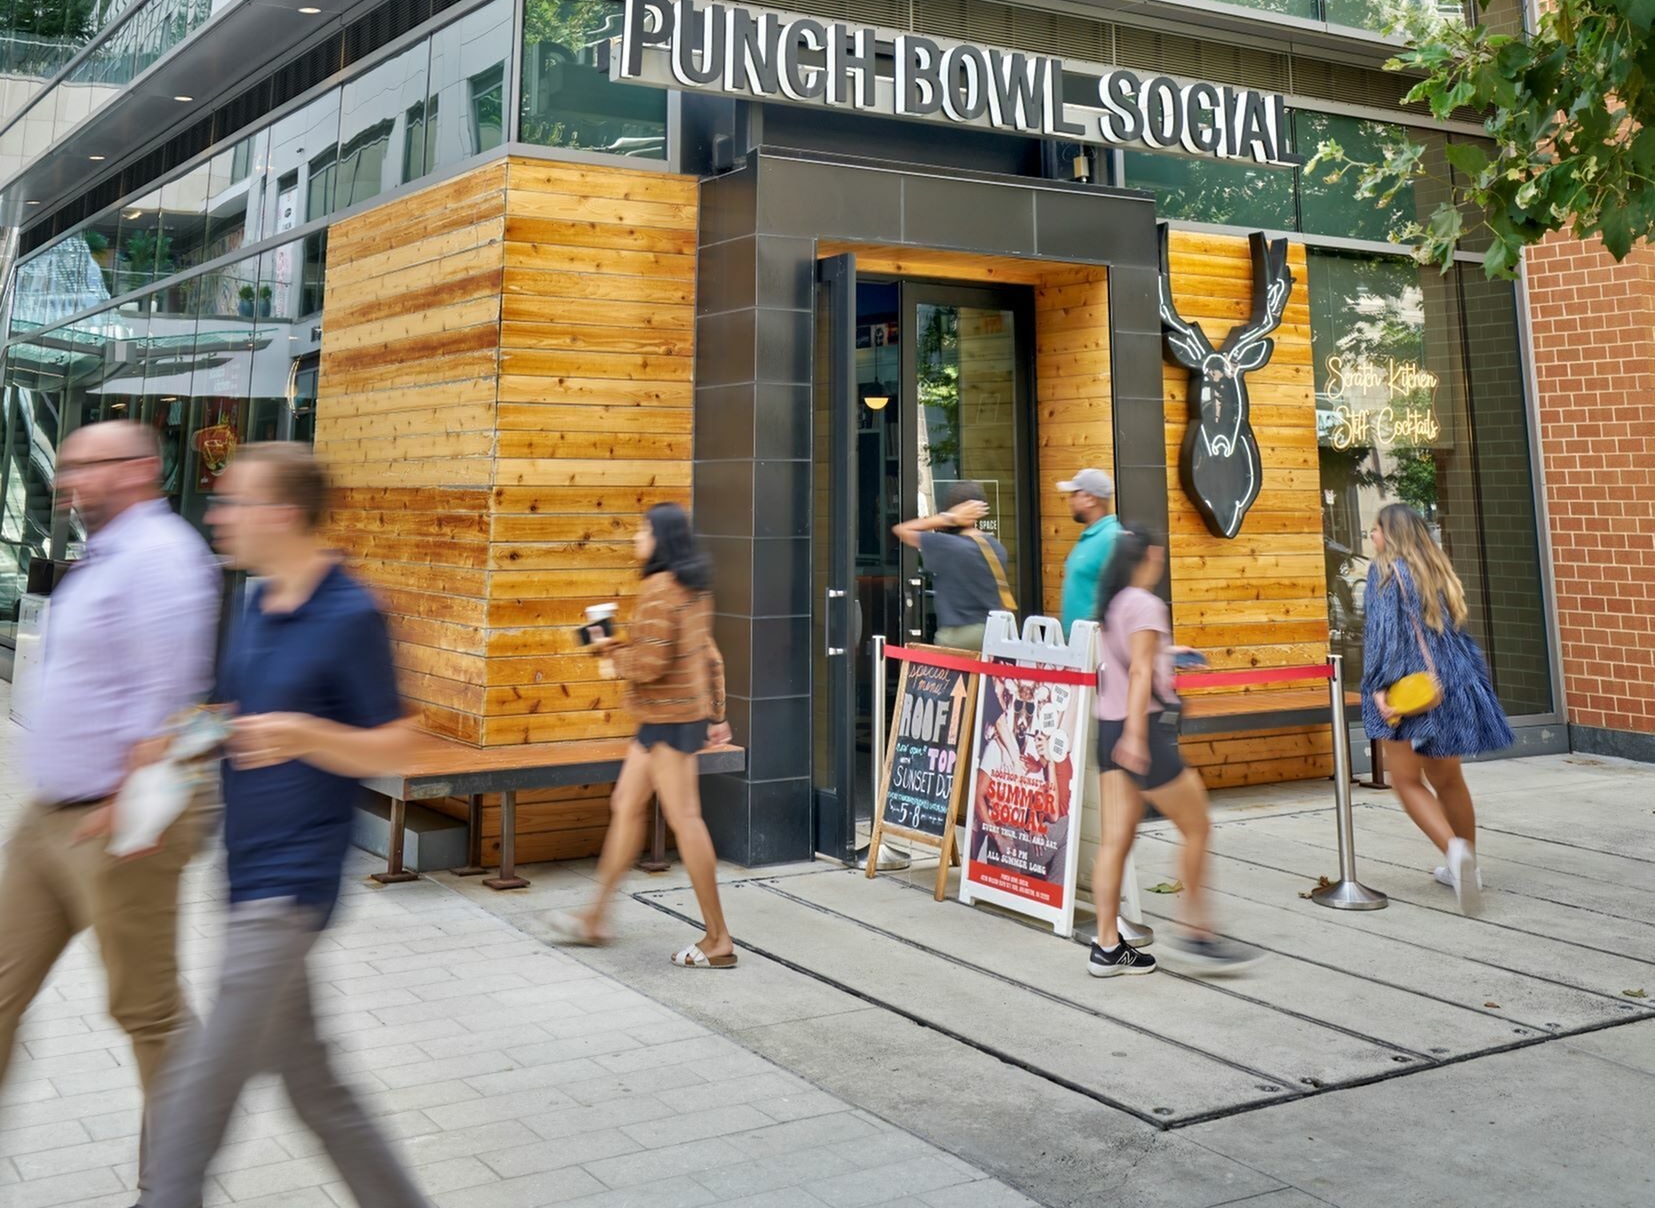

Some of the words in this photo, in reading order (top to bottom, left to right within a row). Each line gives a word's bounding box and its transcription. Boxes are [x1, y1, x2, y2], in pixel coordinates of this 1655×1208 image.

[893, 35, 1086, 135] BOWL
[1098, 70, 1304, 167] SOCIAL
[1327, 357, 1382, 399] Scratch
[1388, 358, 1437, 399] Kitchen
[1334, 406, 1370, 449] Stiff
[1378, 407, 1438, 444] Cocktails
[979, 520, 997, 530] SPACE
[899, 693, 950, 743] ROOF
[927, 748, 957, 773] TOP
[893, 765, 935, 794] SUNSET
[987, 780, 1056, 814] SUMMER
[990, 802, 1048, 834] SOCIAL
[987, 850, 1000, 861] ALL
